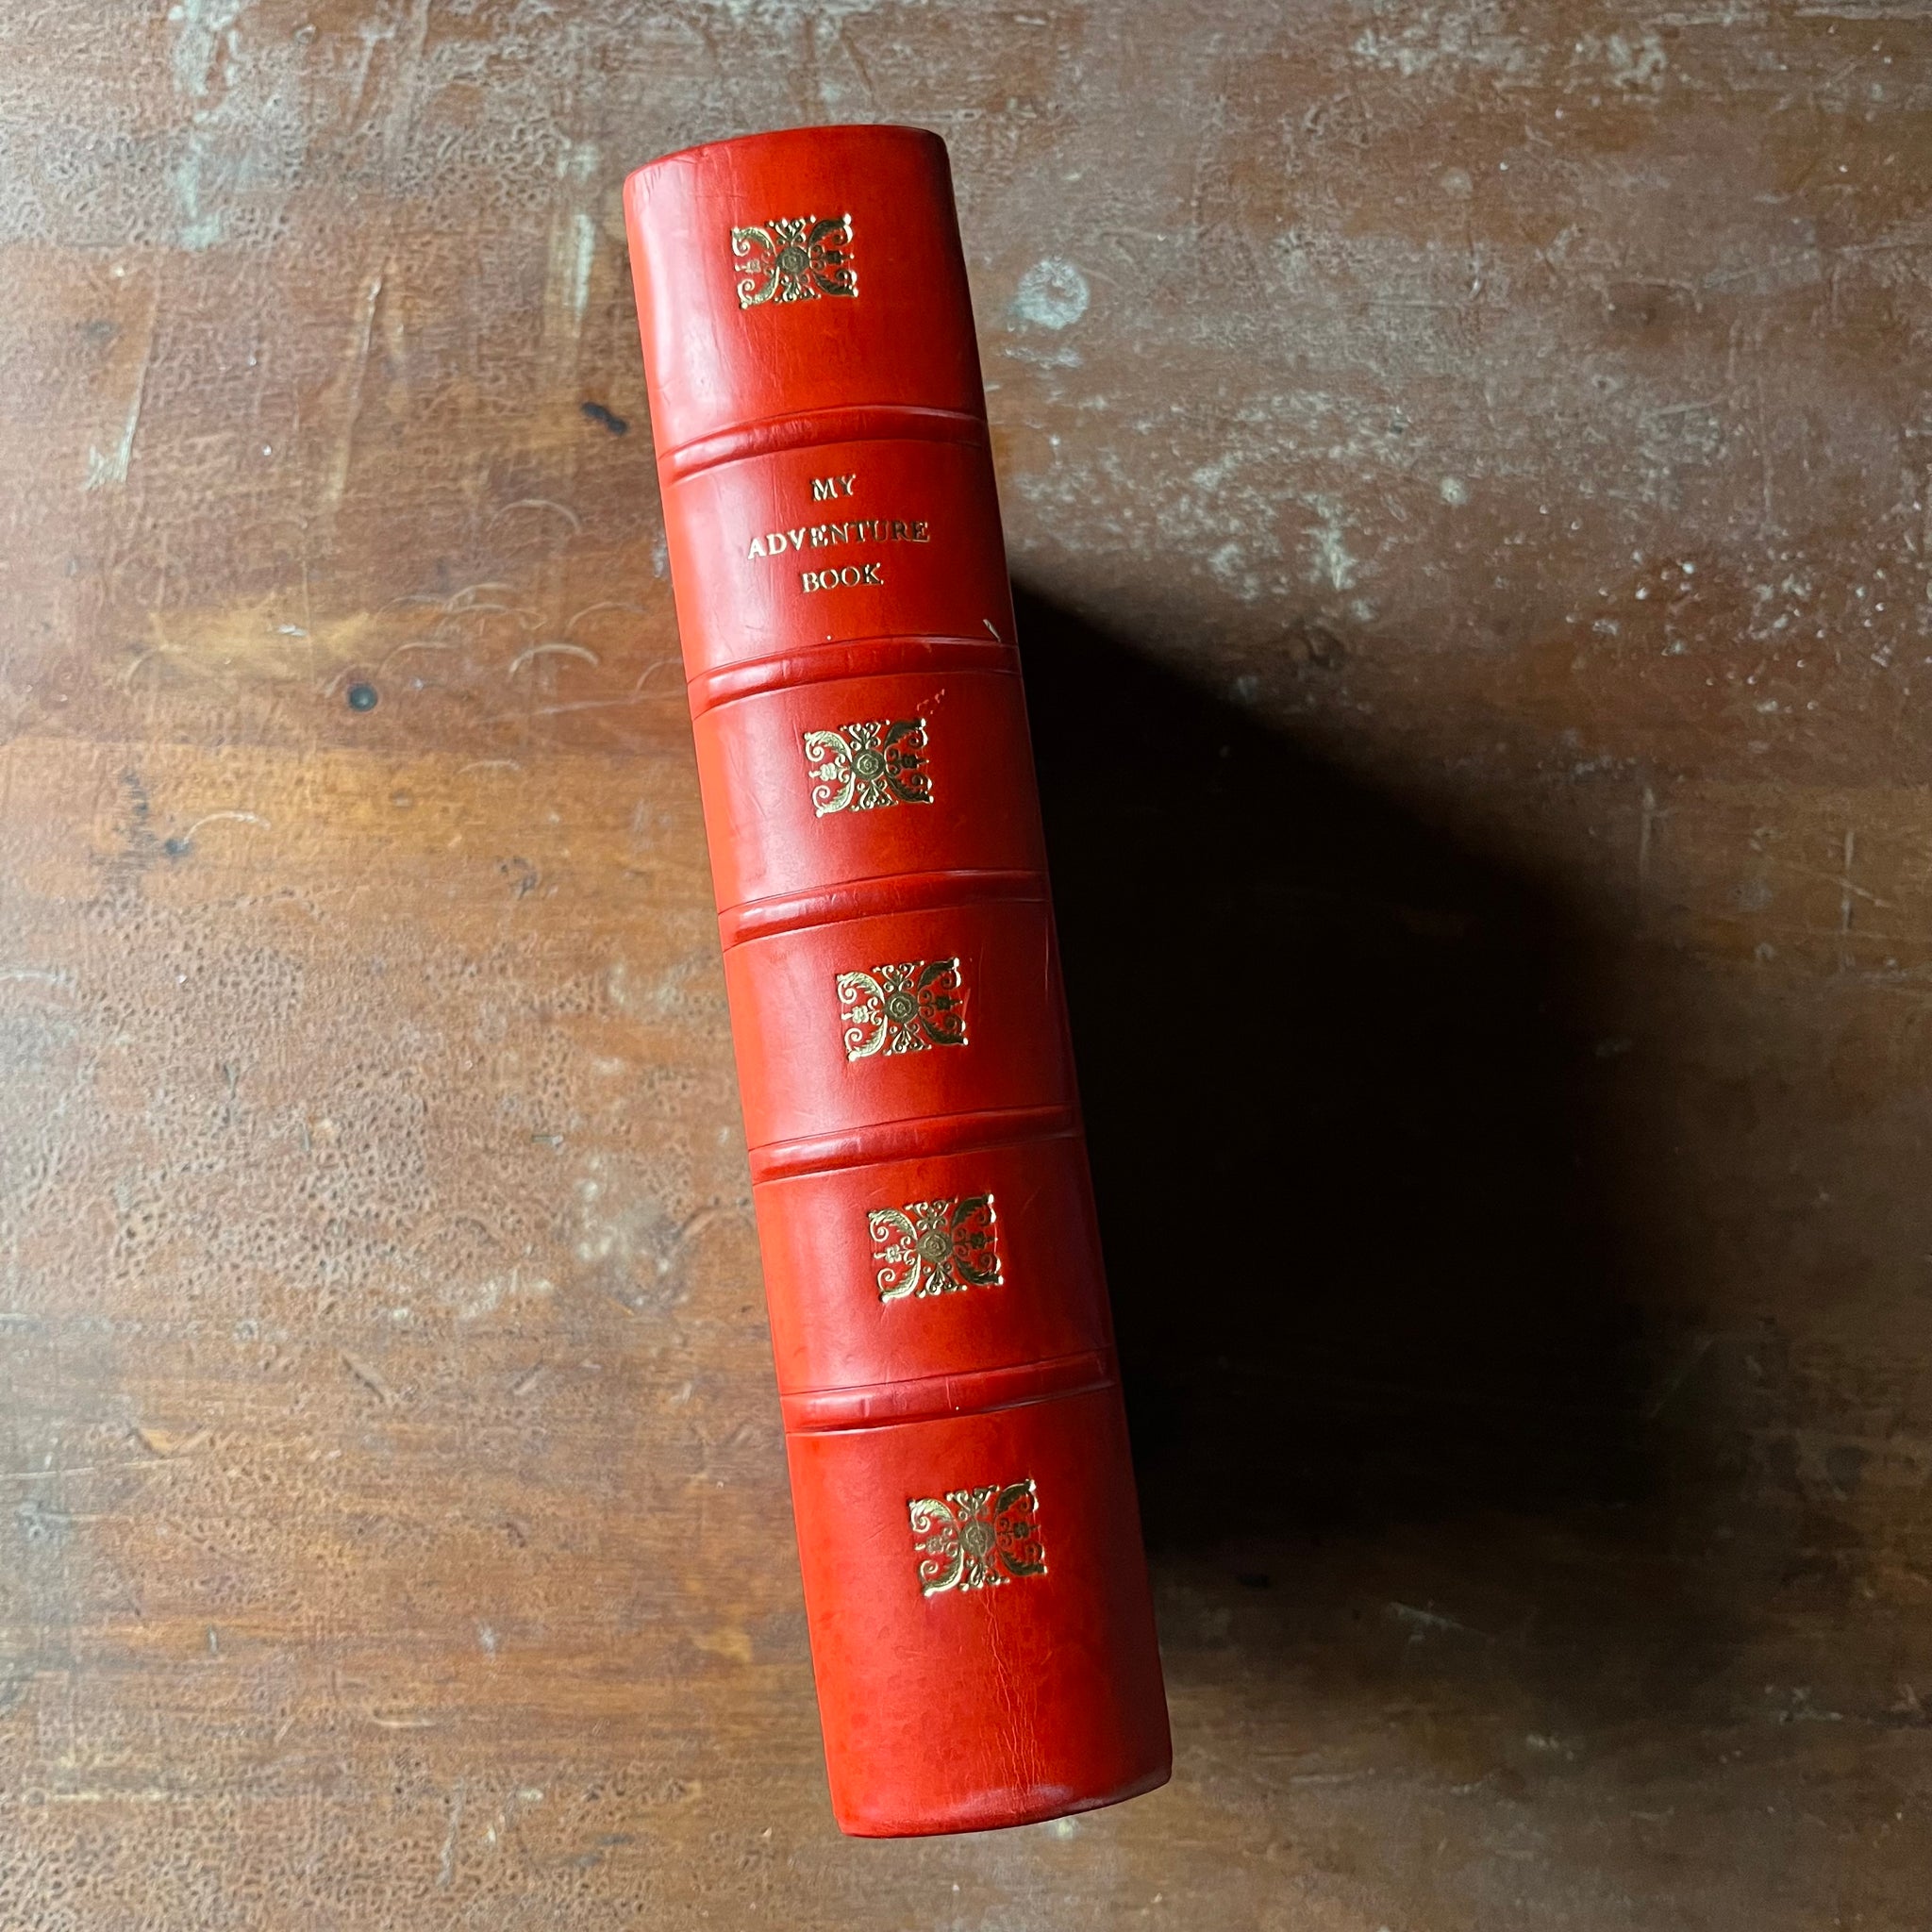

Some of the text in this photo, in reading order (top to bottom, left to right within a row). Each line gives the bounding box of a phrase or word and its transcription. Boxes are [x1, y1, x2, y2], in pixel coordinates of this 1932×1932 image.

[811, 474, 856, 501] MY
[747, 520, 930, 559] ADVENTURE
[802, 562, 884, 592] BOOK
